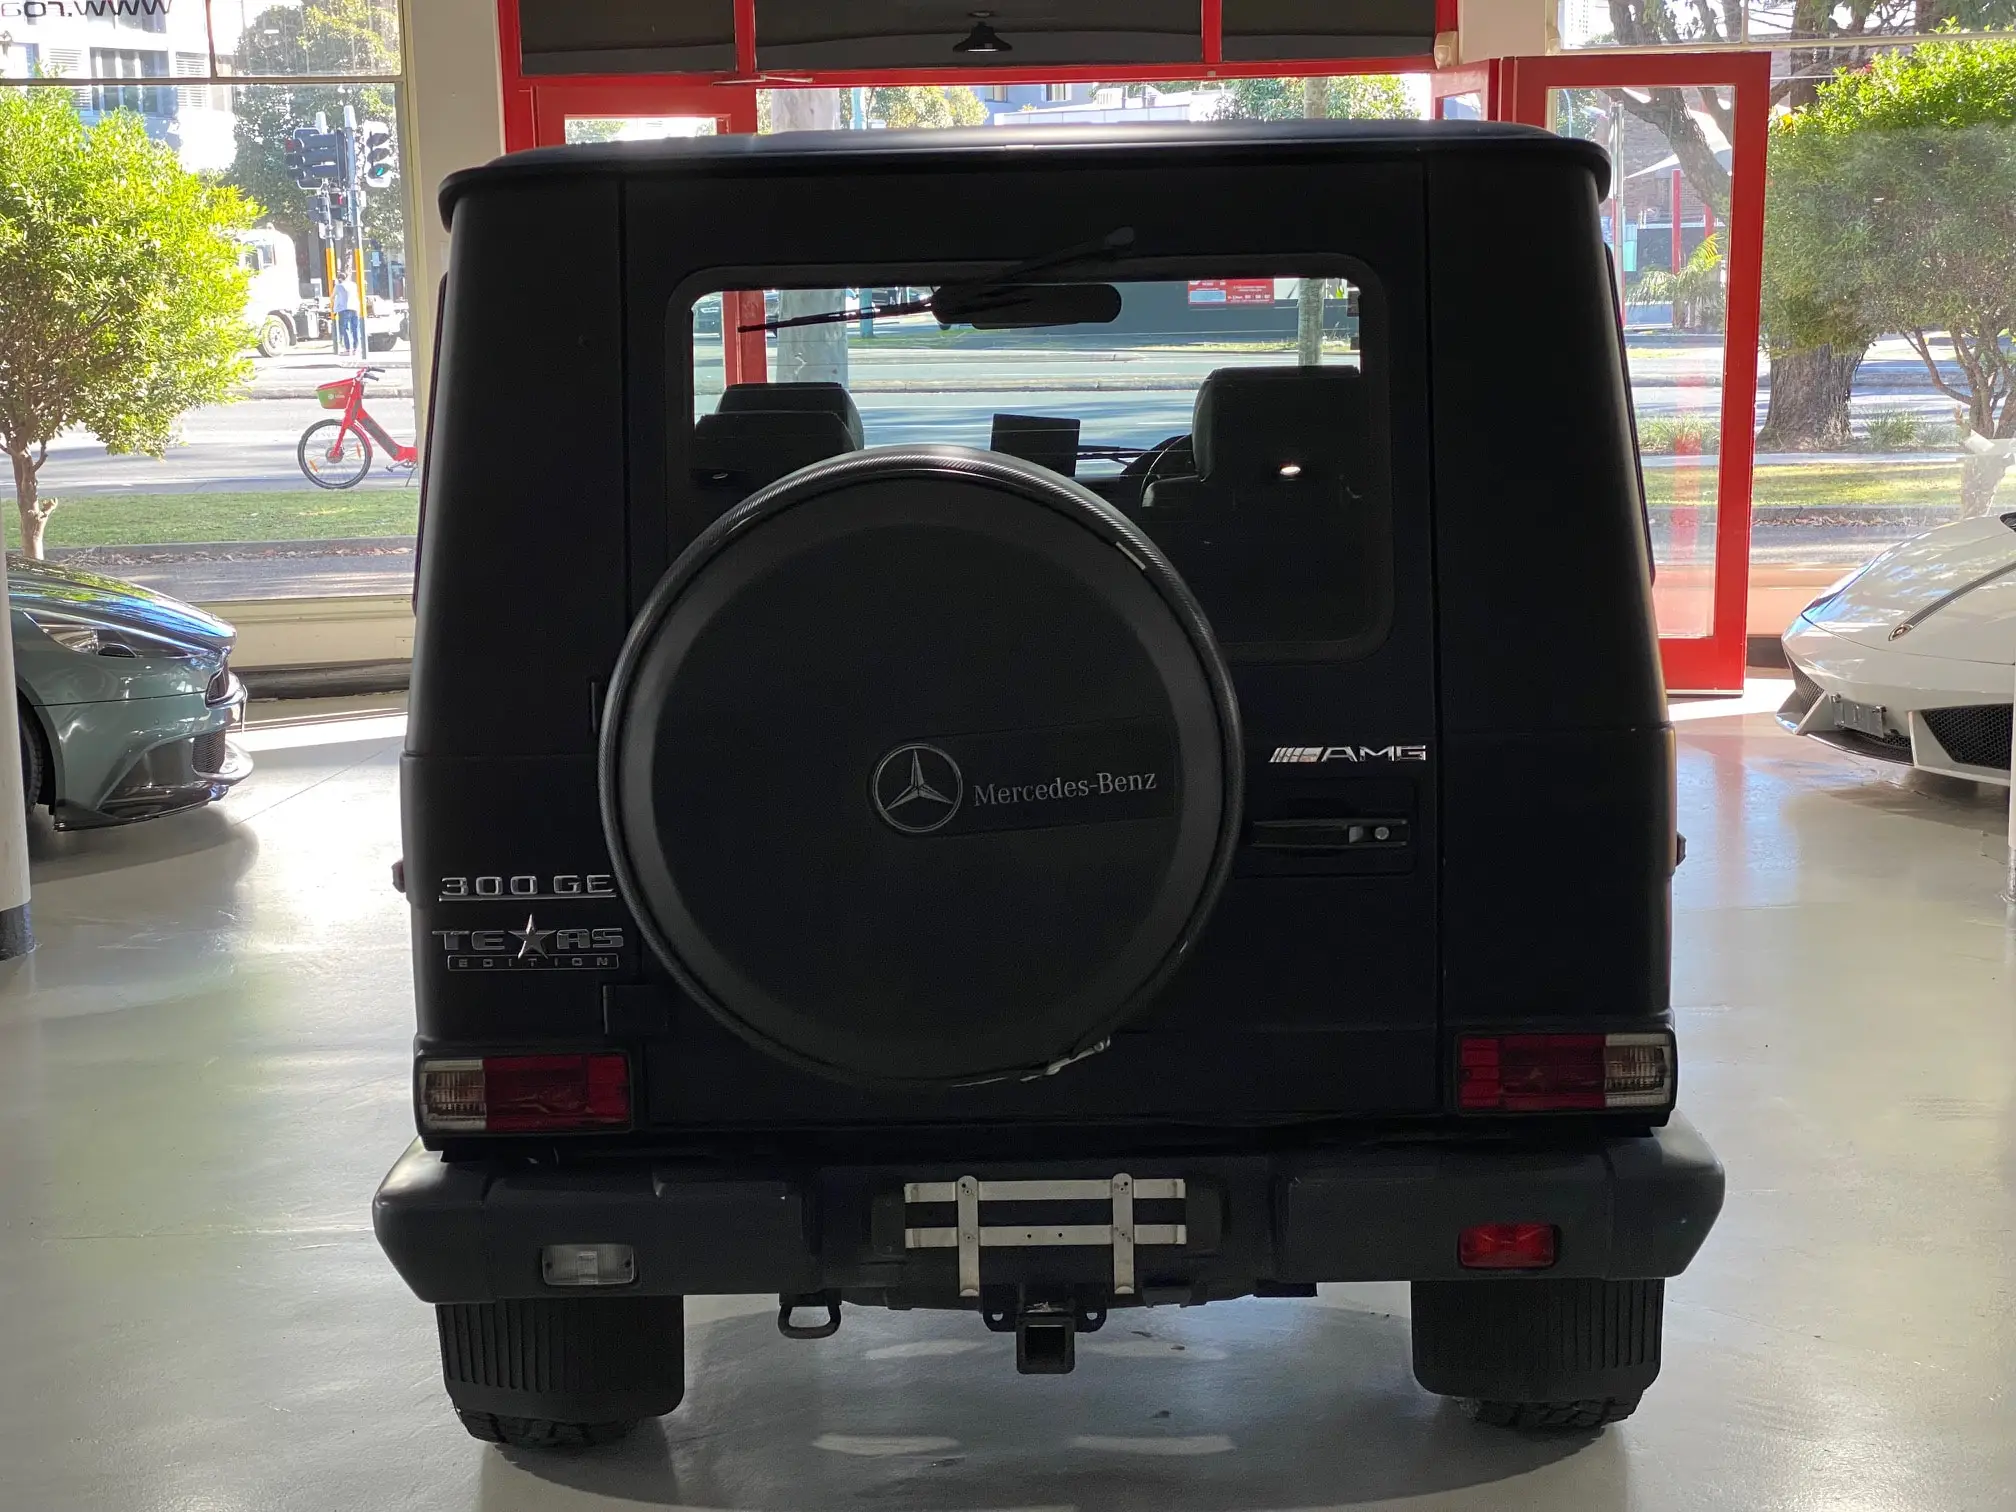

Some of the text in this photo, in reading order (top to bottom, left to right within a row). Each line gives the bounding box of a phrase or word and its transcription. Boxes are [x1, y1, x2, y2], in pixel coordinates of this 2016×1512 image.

[1321, 745, 1427, 762] AMG
[972, 772, 1158, 807] Mercedes-Benz
[441, 874, 614, 896] 300 GE
[458, 957, 609, 969] EDITION
